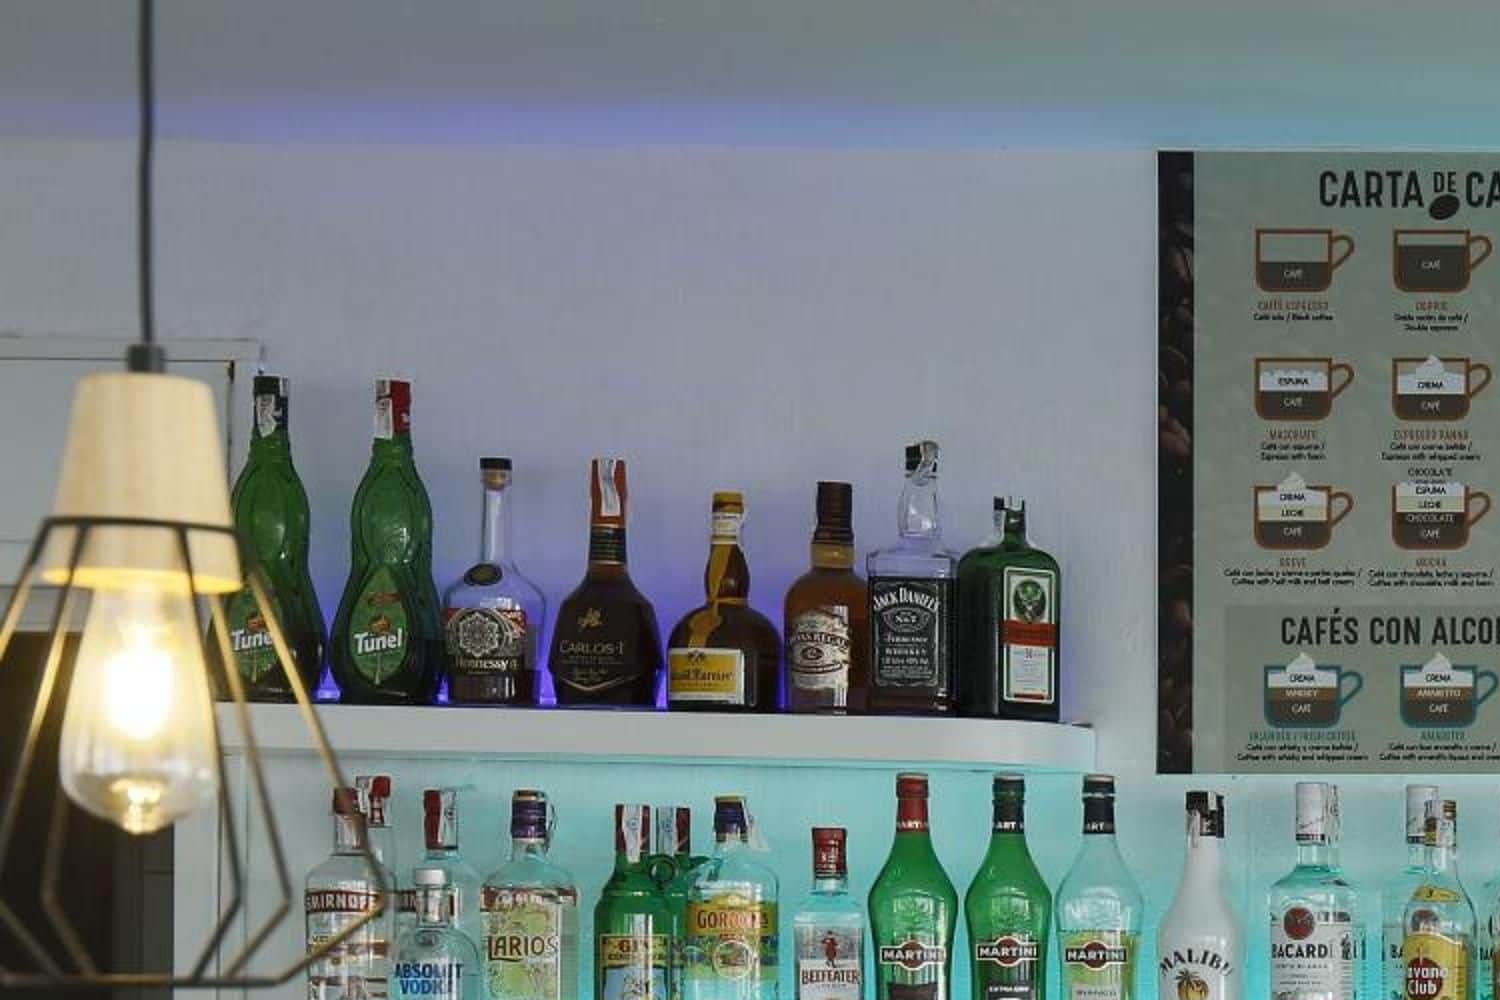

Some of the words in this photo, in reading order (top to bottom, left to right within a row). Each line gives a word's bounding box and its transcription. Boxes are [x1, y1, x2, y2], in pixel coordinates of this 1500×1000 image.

[1319, 171, 1424, 208] CARTA
[1433, 172, 1457, 193] DE
[1280, 608, 1360, 647] CAFÉS
[1369, 616, 1422, 647] CON
[231, 629, 274, 651] Tune
[353, 628, 403, 654] Tunel
[488, 935, 559, 963] LARIOS
[882, 949, 943, 961] MARTINI
[978, 946, 1038, 958] MARTINI
[1067, 950, 1126, 961] MARTINI
[801, 969, 861, 985] BEEFEATER
